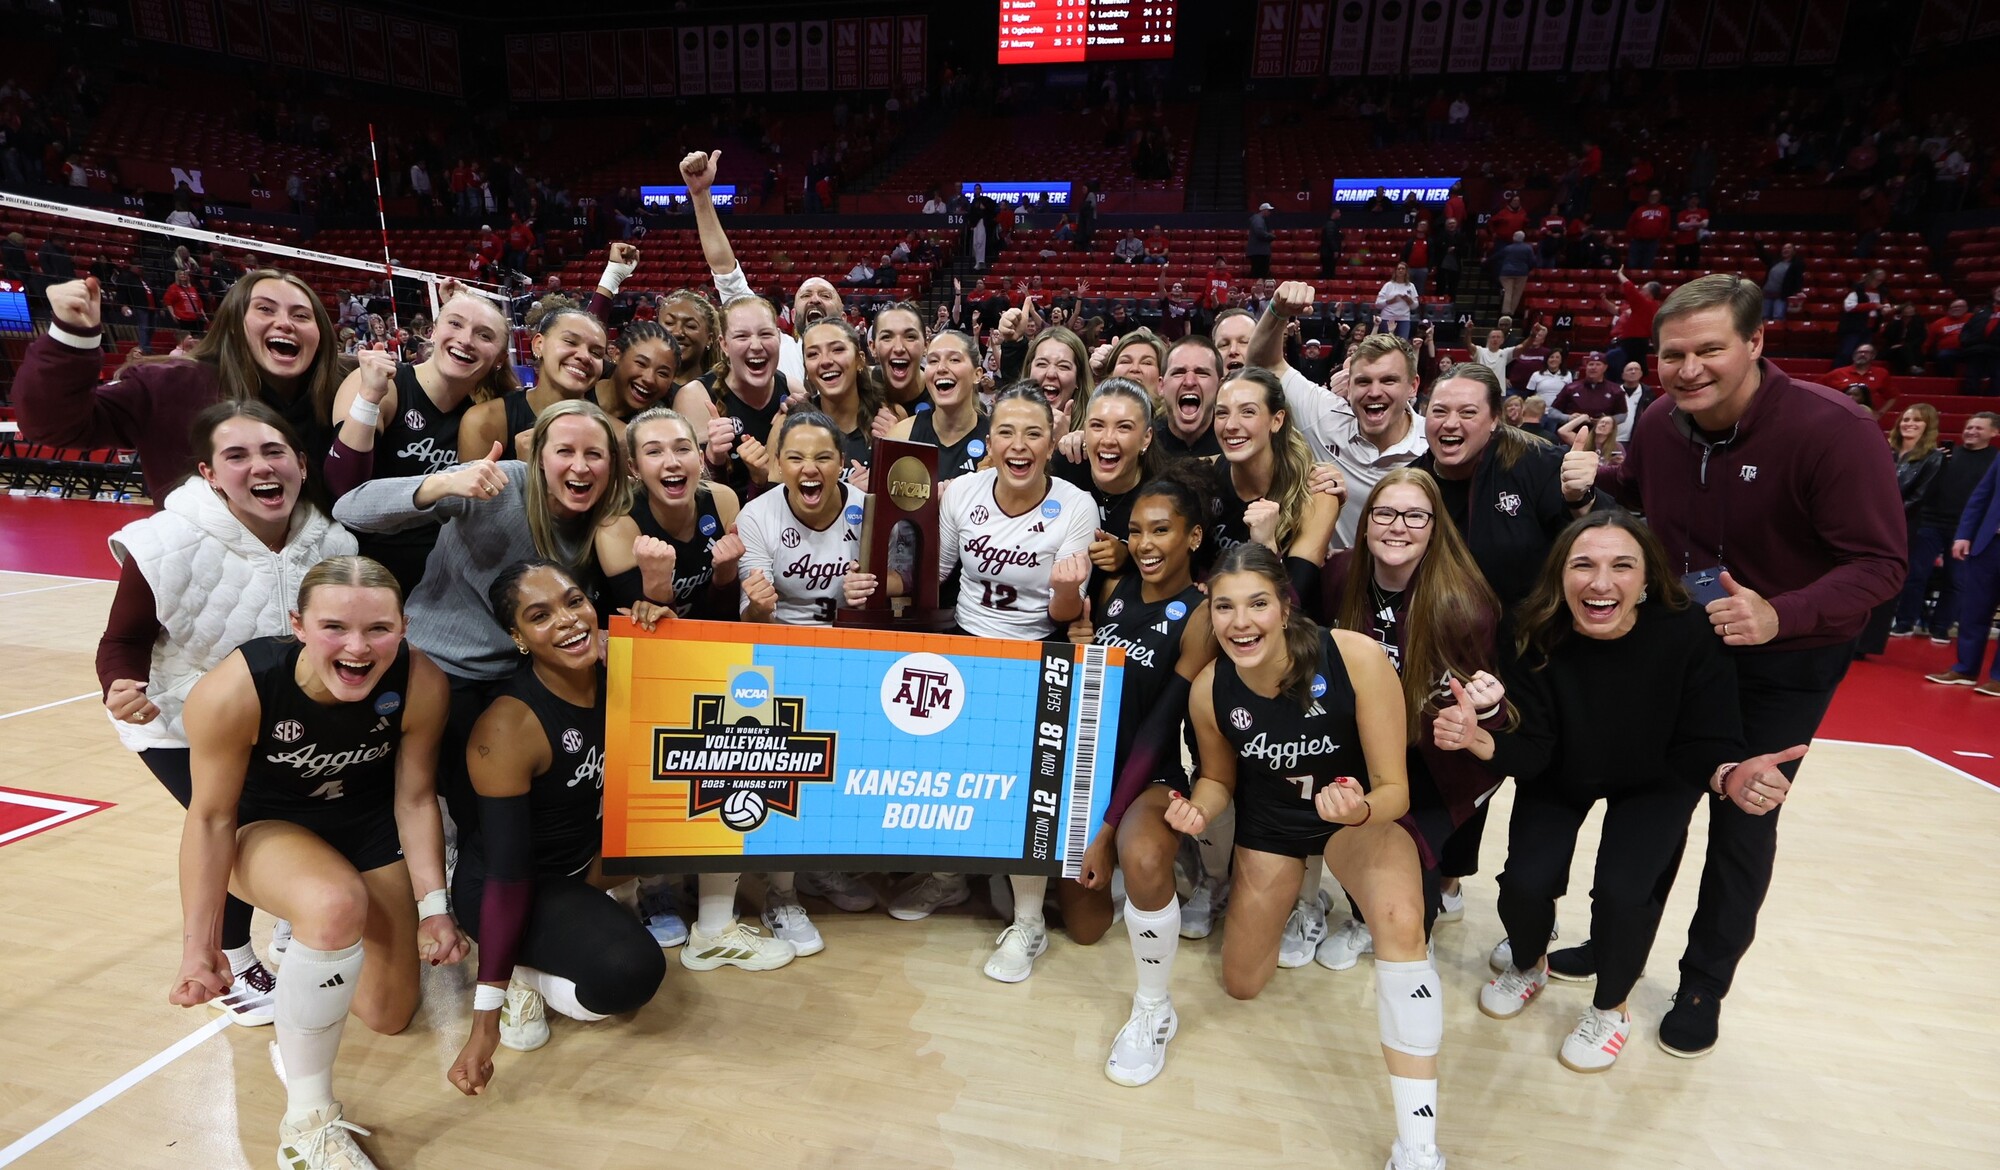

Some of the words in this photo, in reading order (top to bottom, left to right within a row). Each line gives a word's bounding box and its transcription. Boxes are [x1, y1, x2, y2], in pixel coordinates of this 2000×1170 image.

[1263, 5, 1285, 30] N
[1301, 3, 1325, 30] N
[837, 23, 857, 46] N
[869, 22, 889, 45] N
[902, 20, 922, 44] N
[1258, 61, 1280, 73] 2015
[1295, 60, 1318, 72] 2017
[170, 168, 204, 193] N
[124, 197, 144, 206] B14
[252, 189, 270, 198] C15
[908, 195, 923, 204] C18
[1048, 192, 1067, 203] ERE
[1297, 191, 1310, 200] C1
[1336, 189, 1400, 201] CHAMPNS
[1426, 189, 1450, 200] HER
[205, 206, 224, 216] B15
[574, 217, 587, 225] B15
[948, 215, 963, 224] B16
[1458, 314, 1472, 325] A1
[1557, 316, 1572, 327] A2
[406, 410, 425, 429] SEC
[397, 437, 458, 475] Agg
[891, 481, 930, 499] NCAA
[970, 506, 989, 525] SEC
[782, 528, 800, 548] SEC
[964, 535, 1040, 575] Aggies
[672, 566, 713, 599] ggie
[783, 554, 858, 590] Aggie
[980, 580, 1018, 611] 12
[1045, 656, 1070, 687] 25
[734, 688, 768, 699] NCAA
[1046, 687, 1062, 712] SEAT
[1231, 709, 1251, 728] SEC
[274, 721, 301, 741] SEC
[562, 730, 582, 752] SEC
[1039, 721, 1063, 750] 18
[705, 735, 787, 750] VOLLEYBALL
[1240, 732, 1340, 770] Aggies
[266, 741, 392, 778] Aggies
[666, 750, 823, 772] CHAMPIONSHIP
[1041, 752, 1056, 777] ROW
[701, 780, 725, 788] 2025
[732, 780, 766, 789] KANSAS
[768, 780, 788, 789] CITY
[844, 769, 951, 797] KANSAS
[956, 773, 1017, 800] CITY
[1286, 775, 1314, 800] 7
[1033, 789, 1057, 817] 12
[882, 803, 974, 830] BOUND
[1033, 817, 1050, 860] SECTION
